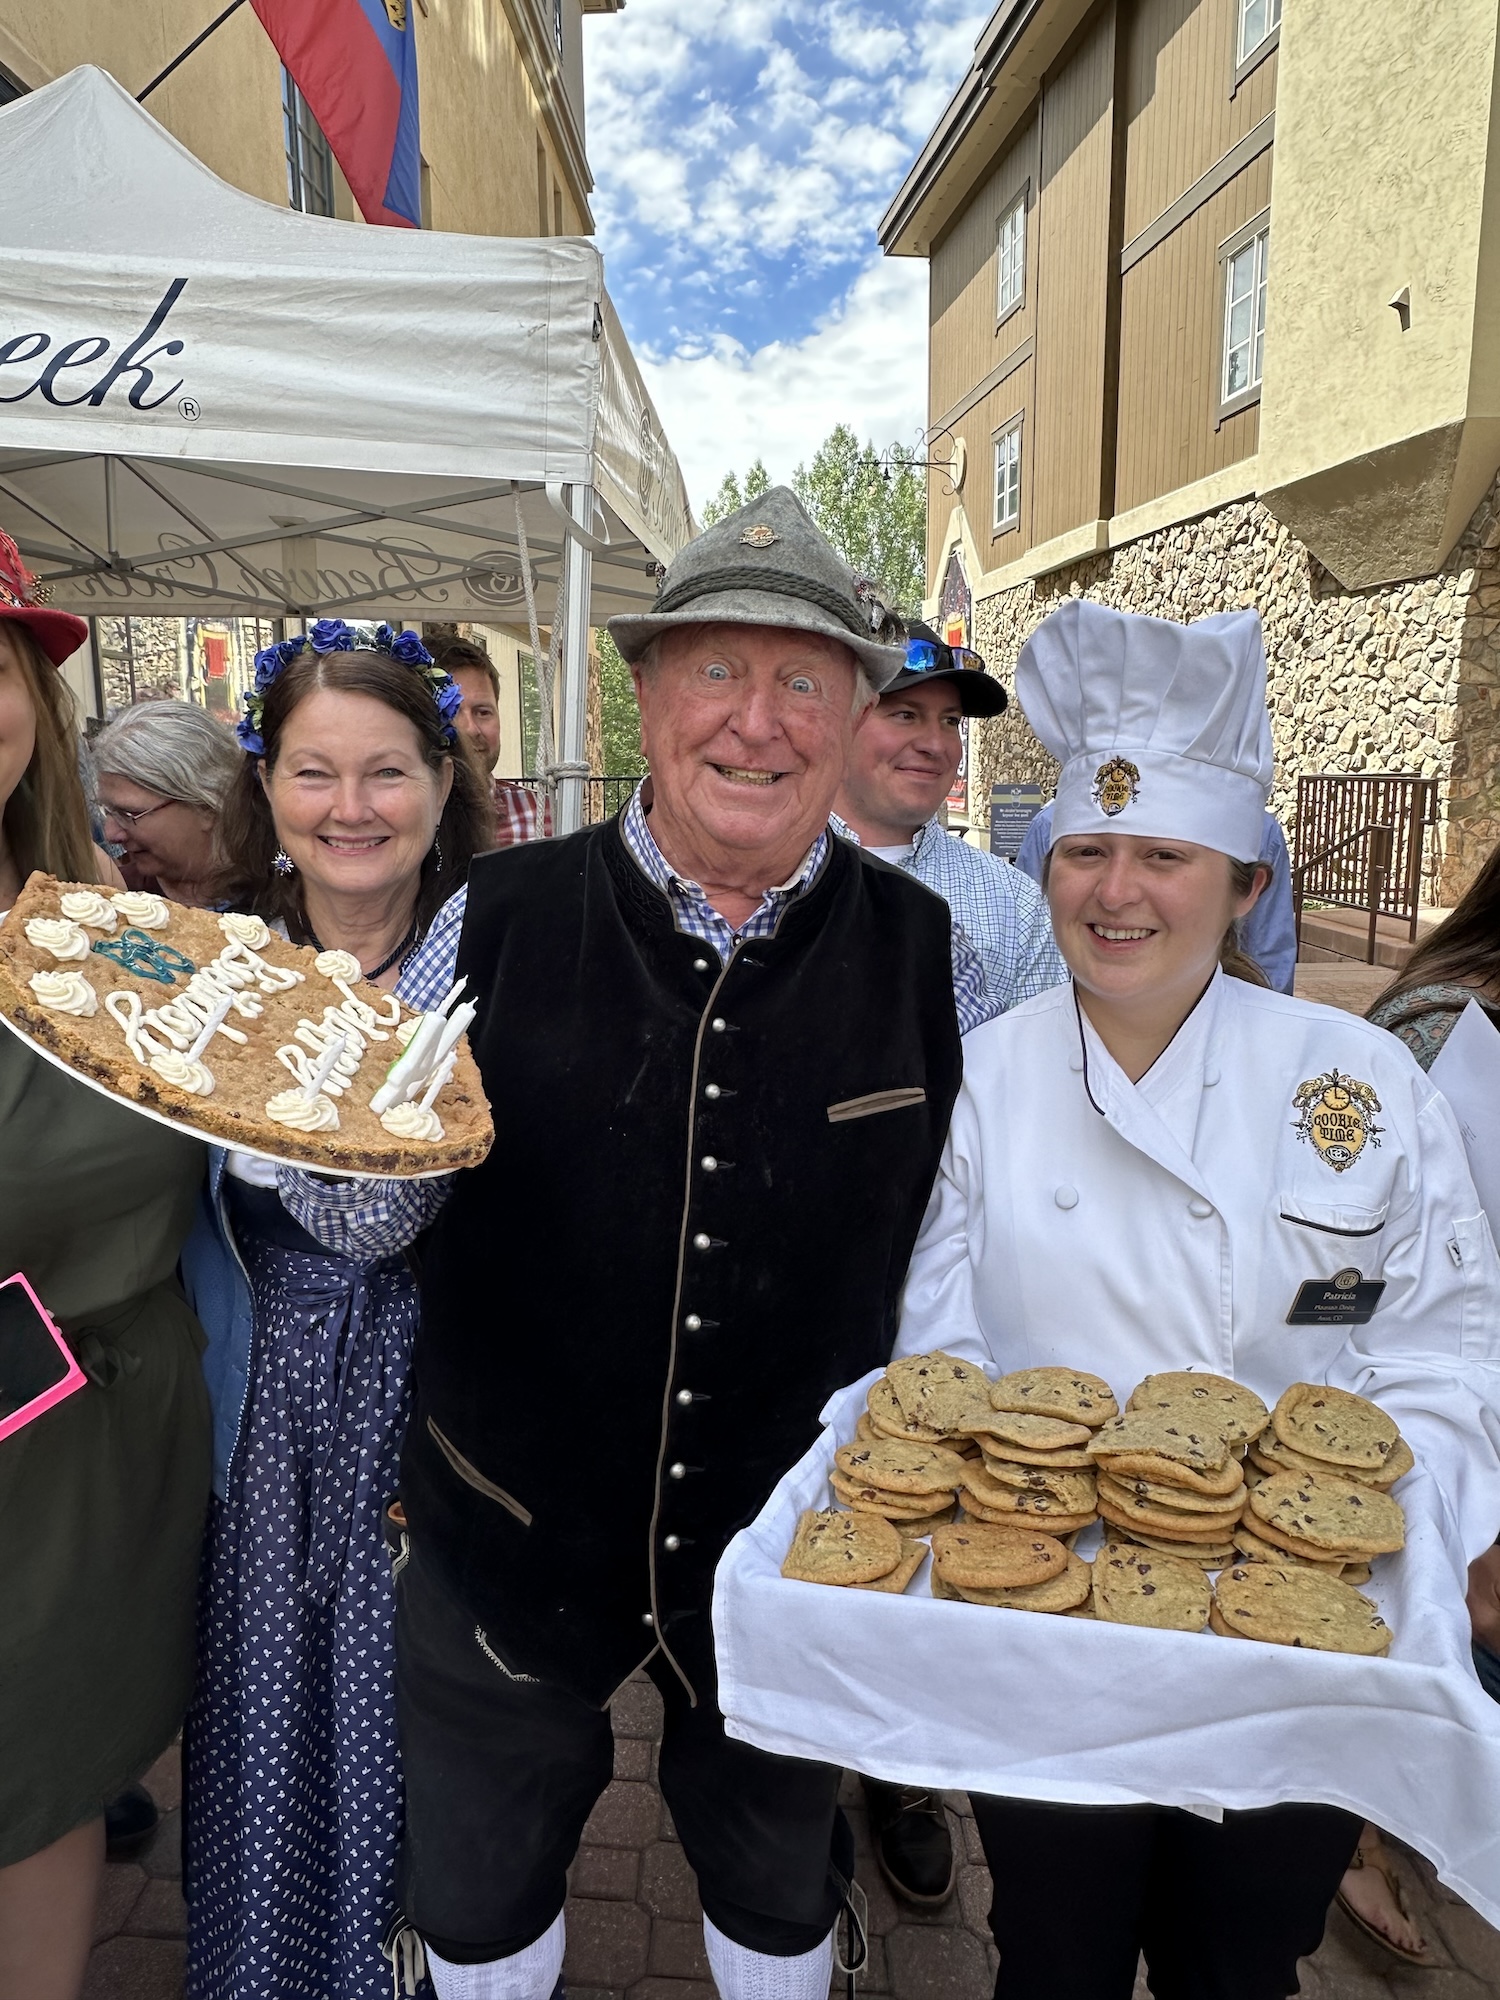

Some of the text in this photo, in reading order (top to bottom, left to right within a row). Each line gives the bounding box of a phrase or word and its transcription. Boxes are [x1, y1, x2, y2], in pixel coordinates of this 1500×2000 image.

[0, 278, 189, 411] eek
[1314, 1113, 1361, 1129] COOKIE
[1320, 1127, 1356, 1142] TIME
[1323, 1292, 1356, 1300] Patricia
